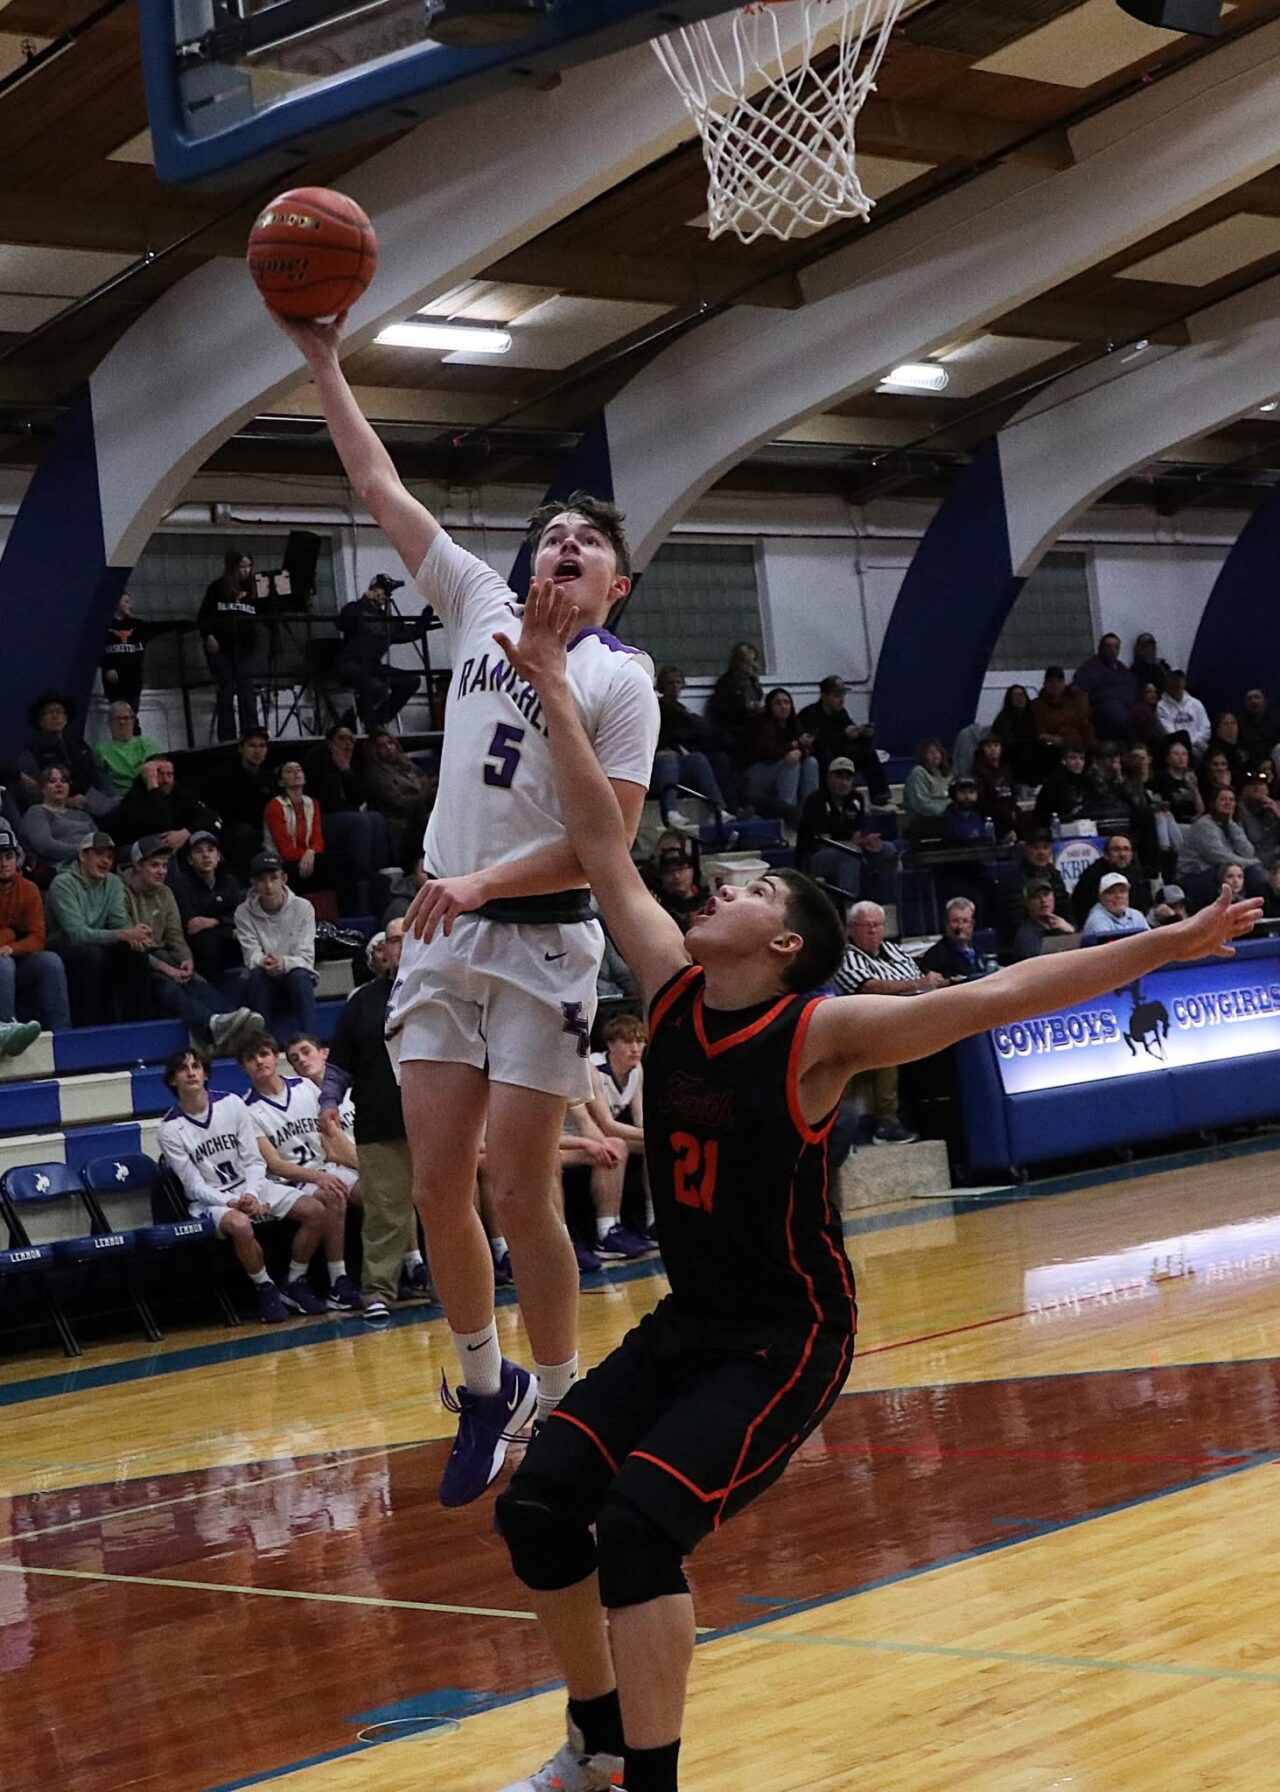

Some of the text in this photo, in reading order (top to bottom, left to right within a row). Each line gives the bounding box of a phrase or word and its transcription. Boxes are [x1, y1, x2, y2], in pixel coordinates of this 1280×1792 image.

[484, 722, 525, 789] 5
[994, 1010, 1120, 1059] COWBOYS
[670, 1131, 718, 1214] 21
